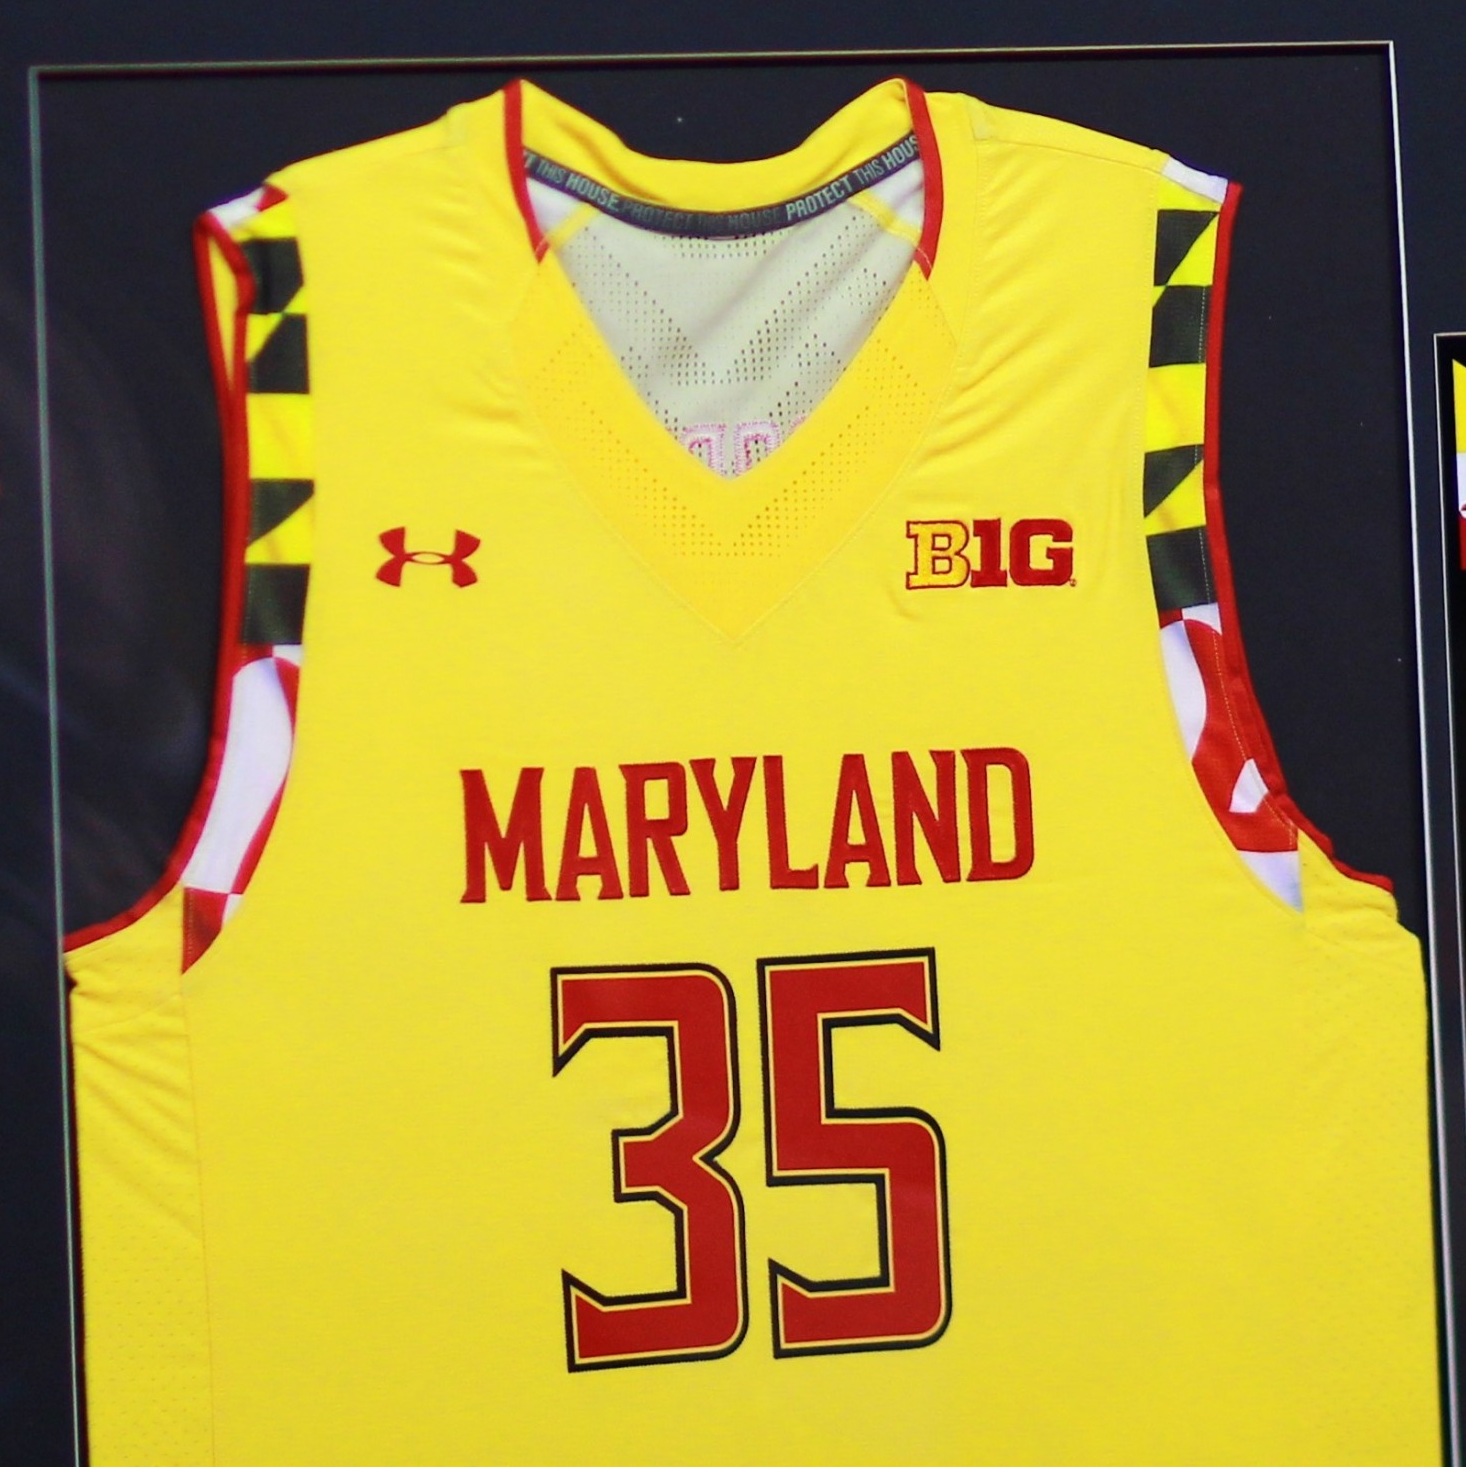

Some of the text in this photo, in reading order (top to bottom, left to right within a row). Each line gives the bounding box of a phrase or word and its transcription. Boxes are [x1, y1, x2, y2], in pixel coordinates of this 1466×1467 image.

[565, 172, 620, 212] HOUSE
[785, 176, 853, 222] PROTECT
[853, 158, 885, 186] THIS
[459, 746, 1035, 903] MARYLAND
[550, 946, 953, 1374] 35
